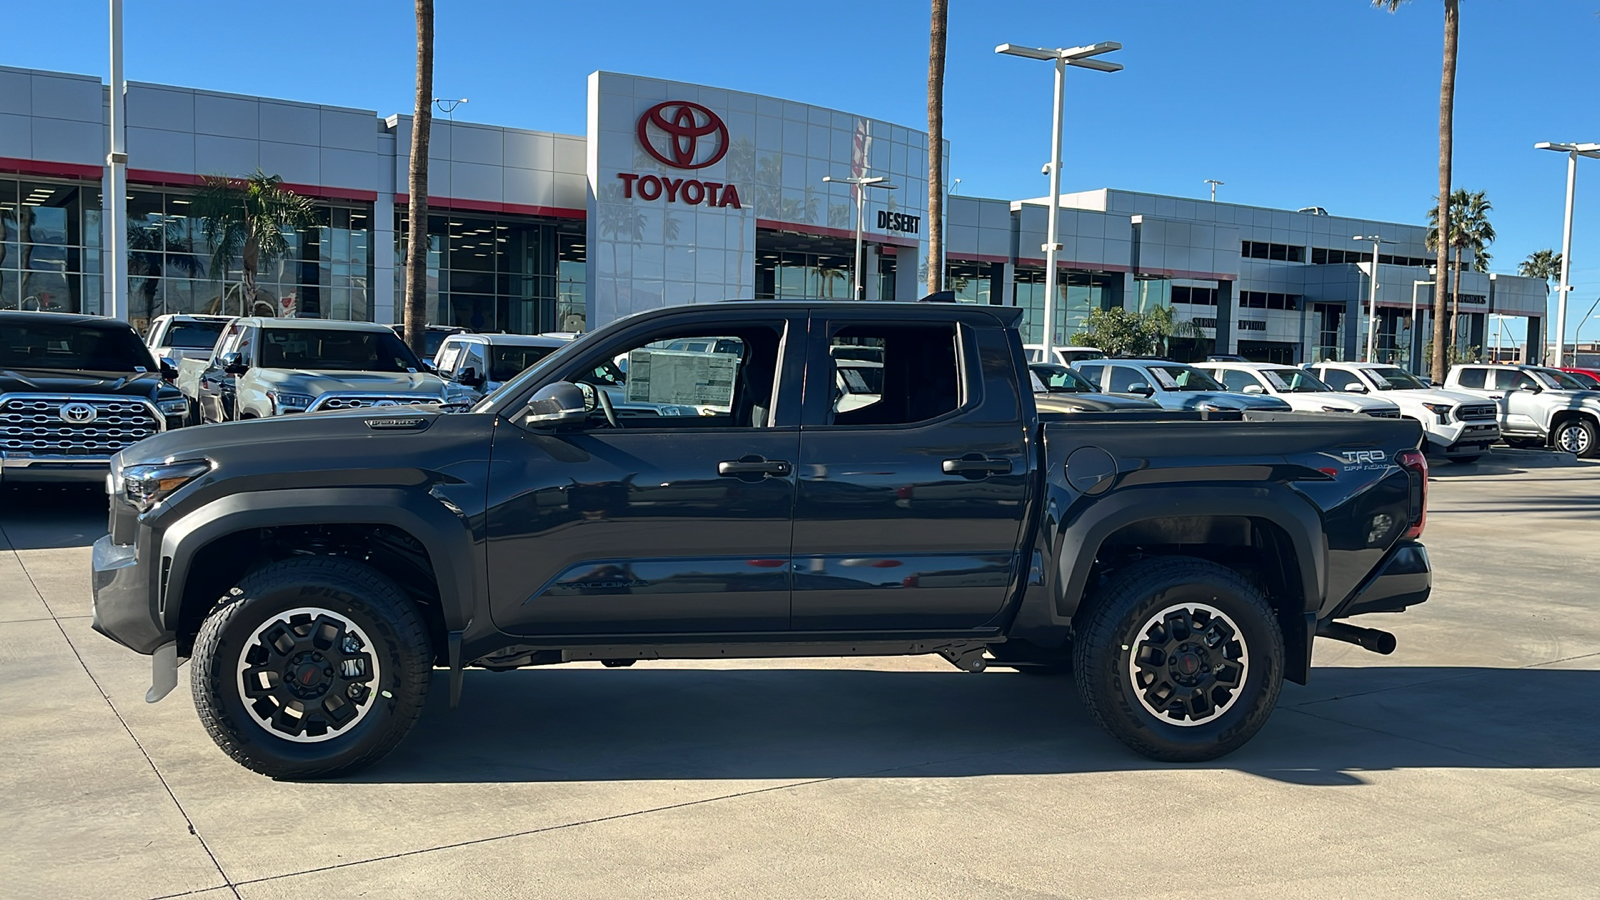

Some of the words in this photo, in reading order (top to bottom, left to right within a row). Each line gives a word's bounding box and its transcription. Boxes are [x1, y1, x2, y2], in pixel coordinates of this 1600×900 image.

[618, 173, 742, 209] TOYOTA
[877, 211, 921, 234] DESERT
[1193, 317, 1217, 328] SERVI
[1238, 320, 1267, 331] EPTION
[1342, 451, 1385, 464] TRD
